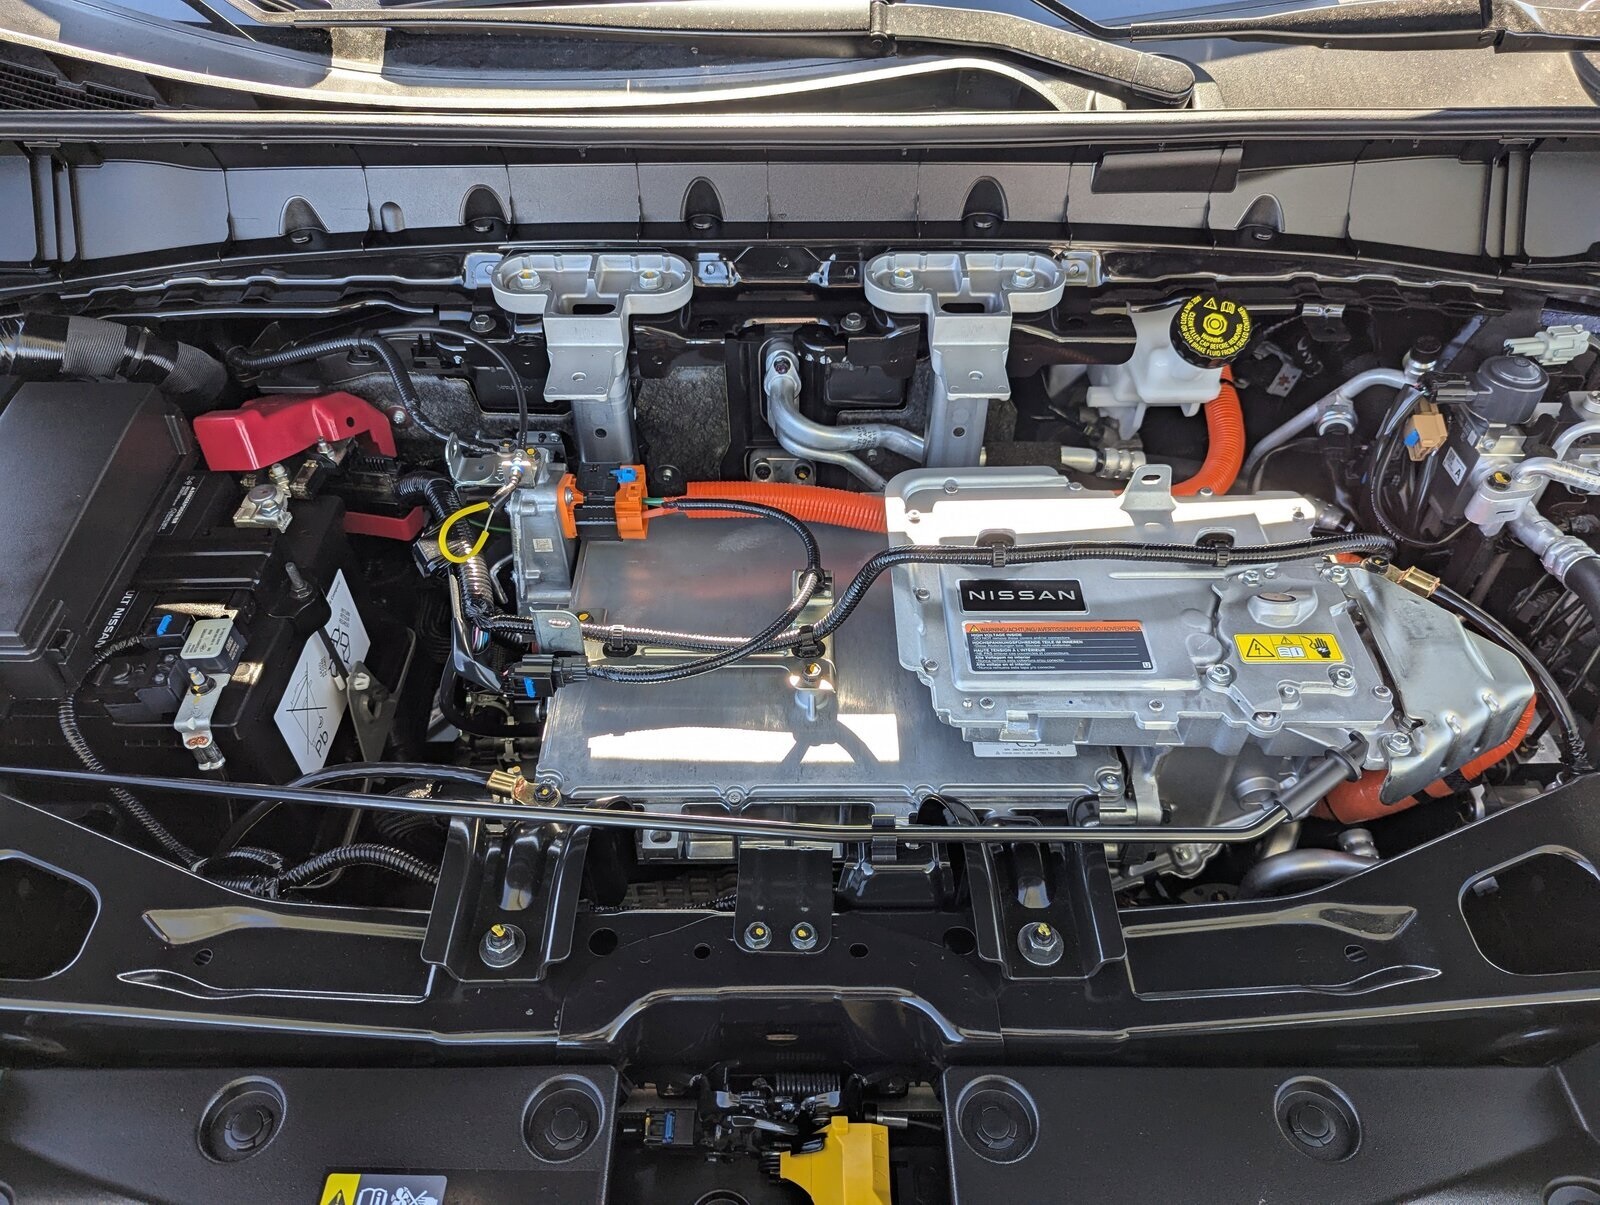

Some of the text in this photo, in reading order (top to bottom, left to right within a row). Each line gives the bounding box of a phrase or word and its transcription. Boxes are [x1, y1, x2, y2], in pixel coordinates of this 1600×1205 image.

[1237, 306, 1250, 331] CONTAINER
[1180, 324, 1188, 332] OR
[1187, 312, 1243, 350] CLEAN FILLER CAP BEFORE REMOVING
[1236, 331, 1249, 347] SEALED
[1190, 341, 1207, 354] BRAKE
[1221, 347, 1236, 355] FROM
[1454, 468, 1461, 479] A
[968, 590, 1076, 600] NISSAN
[94, 590, 136, 648] ULT NISSAN
[314, 729, 329, 758] Pb
